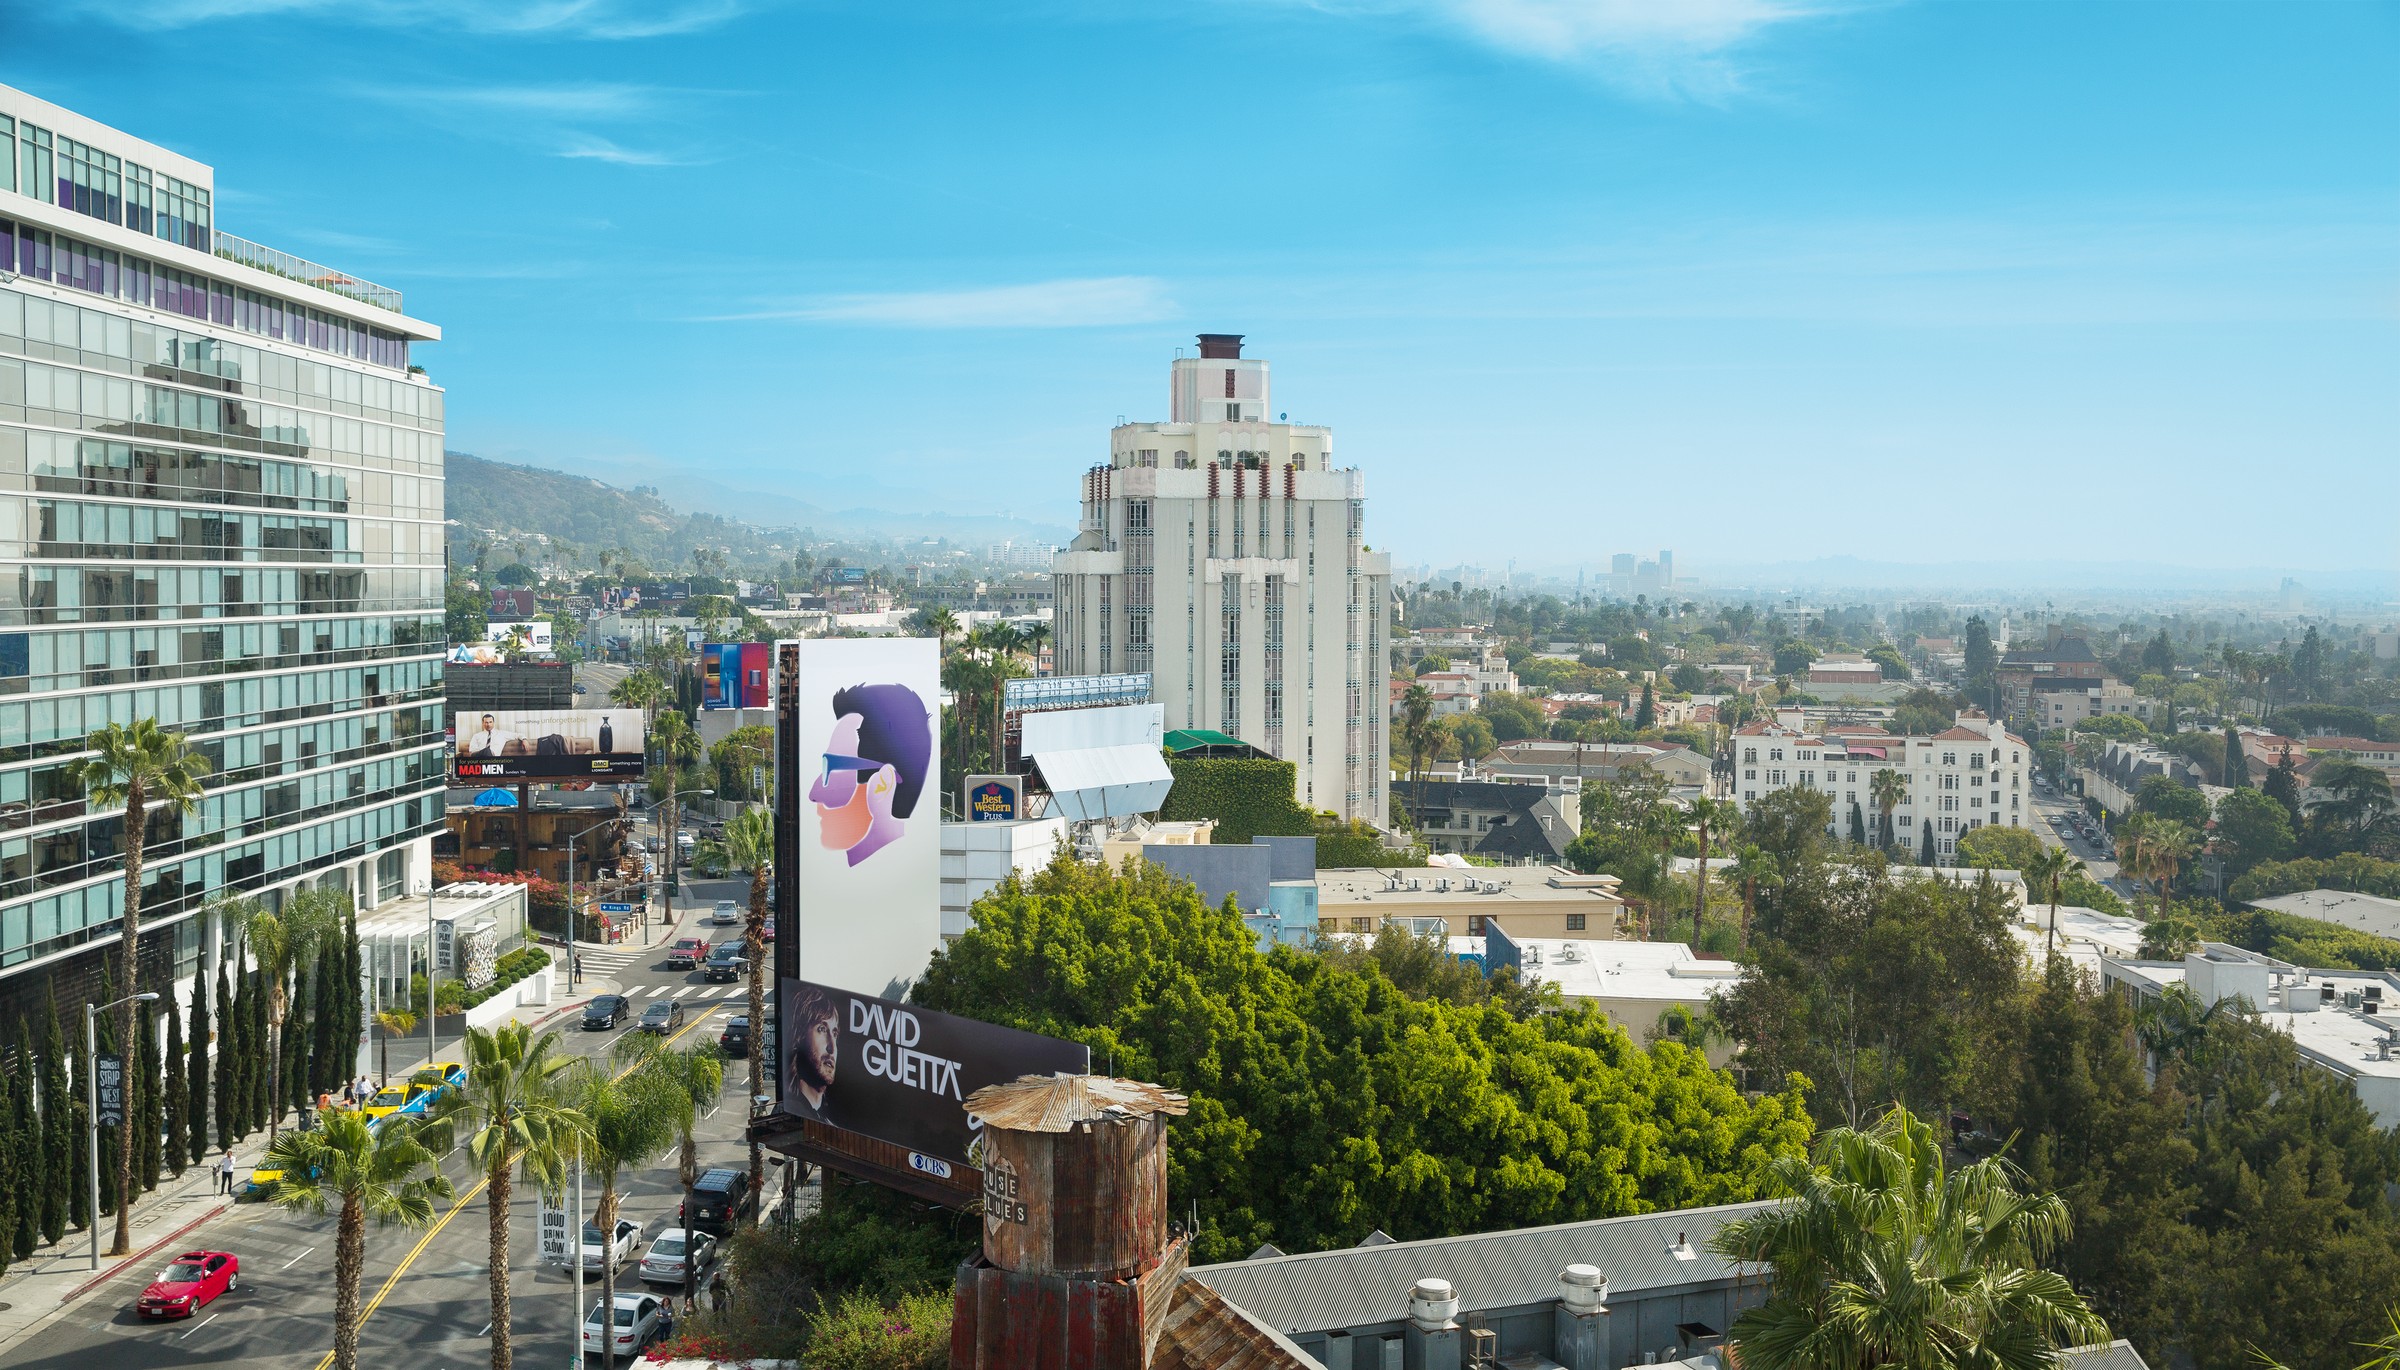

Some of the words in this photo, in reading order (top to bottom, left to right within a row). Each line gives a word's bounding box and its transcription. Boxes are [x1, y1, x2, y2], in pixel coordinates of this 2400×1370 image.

[541, 716, 588, 725] unforgettable
[982, 793, 1003, 804] Best
[974, 801, 1011, 812] Western
[849, 998, 920, 1048] DAVID
[100, 1060, 120, 1069] SUNSET
[862, 1039, 962, 1101] GUETTA
[100, 1070, 120, 1087] STRIP
[101, 1088, 120, 1103] WEST
[925, 1158, 945, 1177] CBS
[986, 1171, 1016, 1195] USE
[984, 1193, 1025, 1222] LUES
[543, 1212, 565, 1228] LOUD
[543, 1229, 565, 1239] DRINK
[543, 1240, 565, 1254] SLOW
